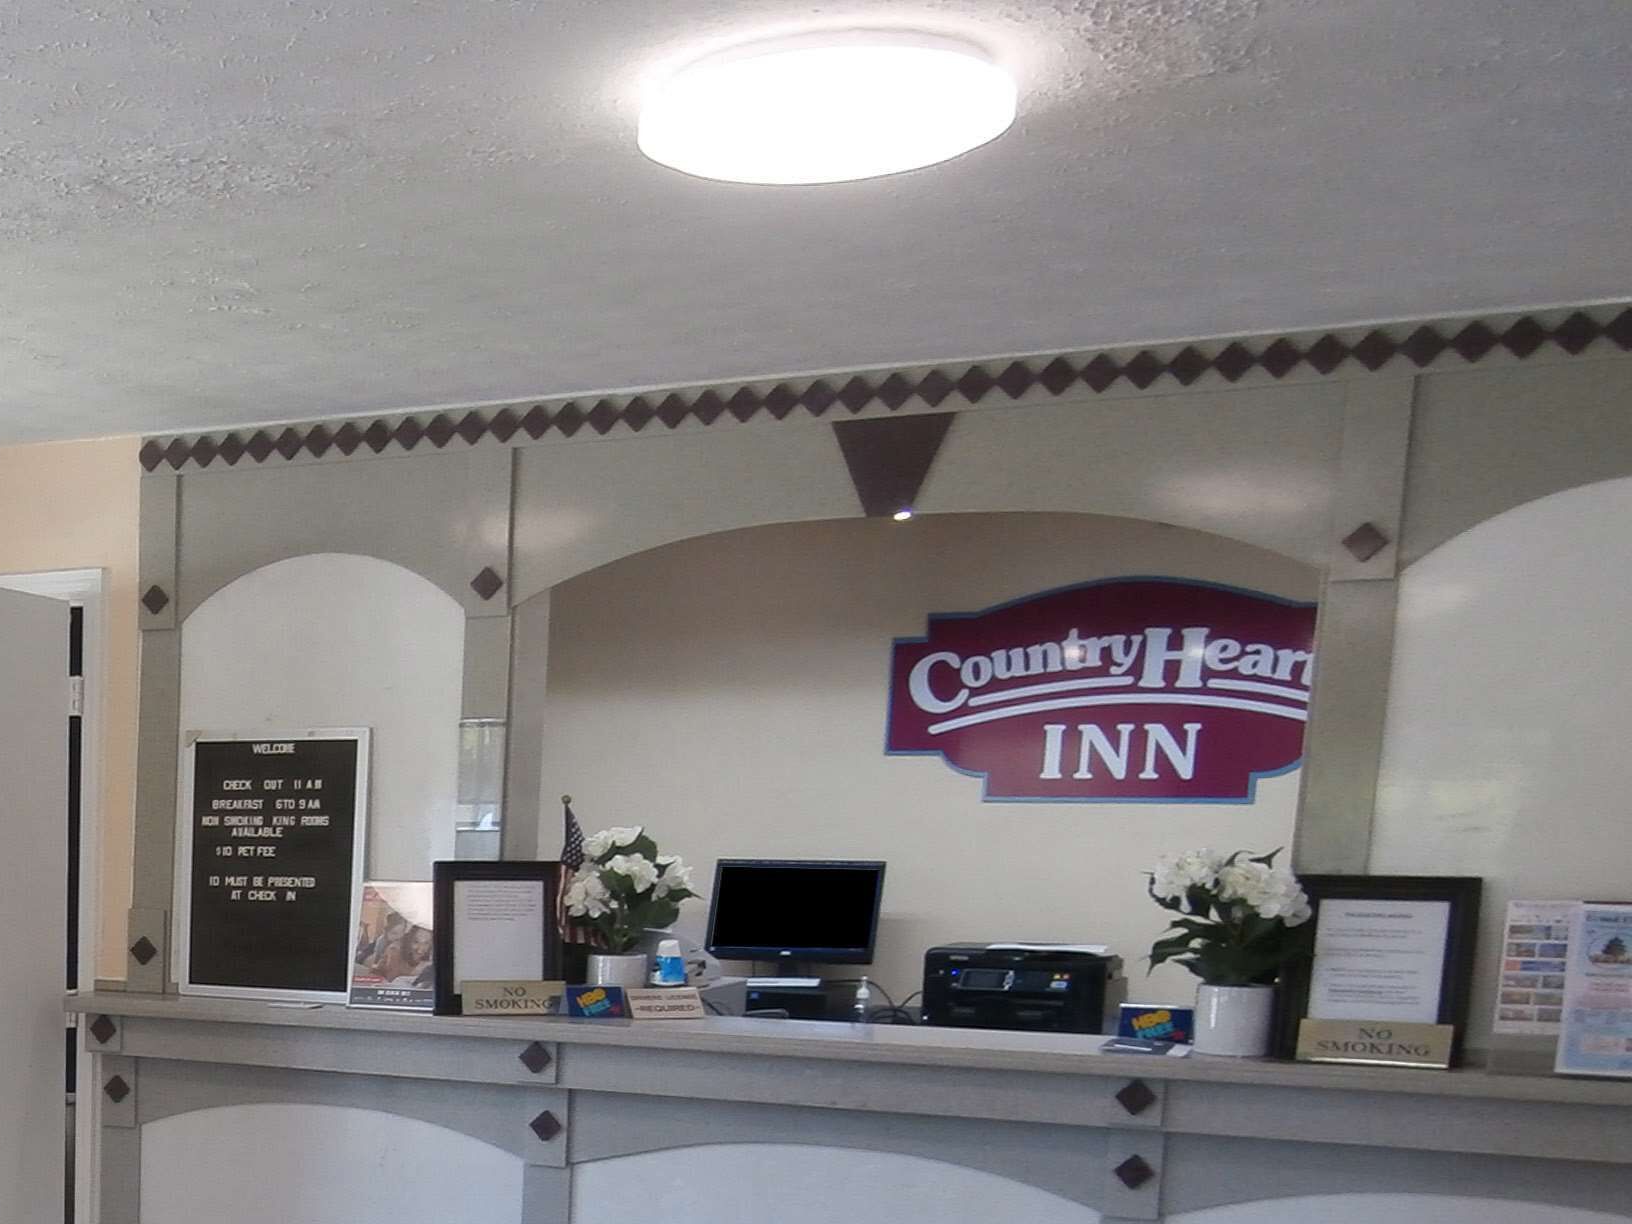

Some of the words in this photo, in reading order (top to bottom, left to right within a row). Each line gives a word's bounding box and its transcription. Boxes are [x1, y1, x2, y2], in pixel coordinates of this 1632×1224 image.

[252, 743, 296, 754] WELCOME
[1039, 723, 1202, 780] INN
[223, 780, 253, 790] CHECK
[263, 780, 284, 790] OUT
[212, 799, 264, 810] BREAKFAST
[201, 816, 219, 826] NON
[224, 816, 264, 826] SMOKING
[272, 816, 296, 826] KING
[300, 816, 329, 827] ROOMS
[231, 827, 284, 838] AVAILABLE
[237, 846, 255, 857] PET
[256, 846, 276, 857] FEE
[209, 876, 220, 887] ID
[225, 876, 248, 887] MUST
[253, 876, 265, 887] BE
[267, 876, 316, 887] PRESENTED
[231, 890, 242, 900] AT
[248, 890, 276, 901] CHECK
[285, 891, 296, 901] IN
[503, 986, 526, 997] NO
[474, 998, 553, 1010] SMOKING
[1357, 1027, 1393, 1040] NO
[1317, 1040, 1431, 1057] SMOKING
